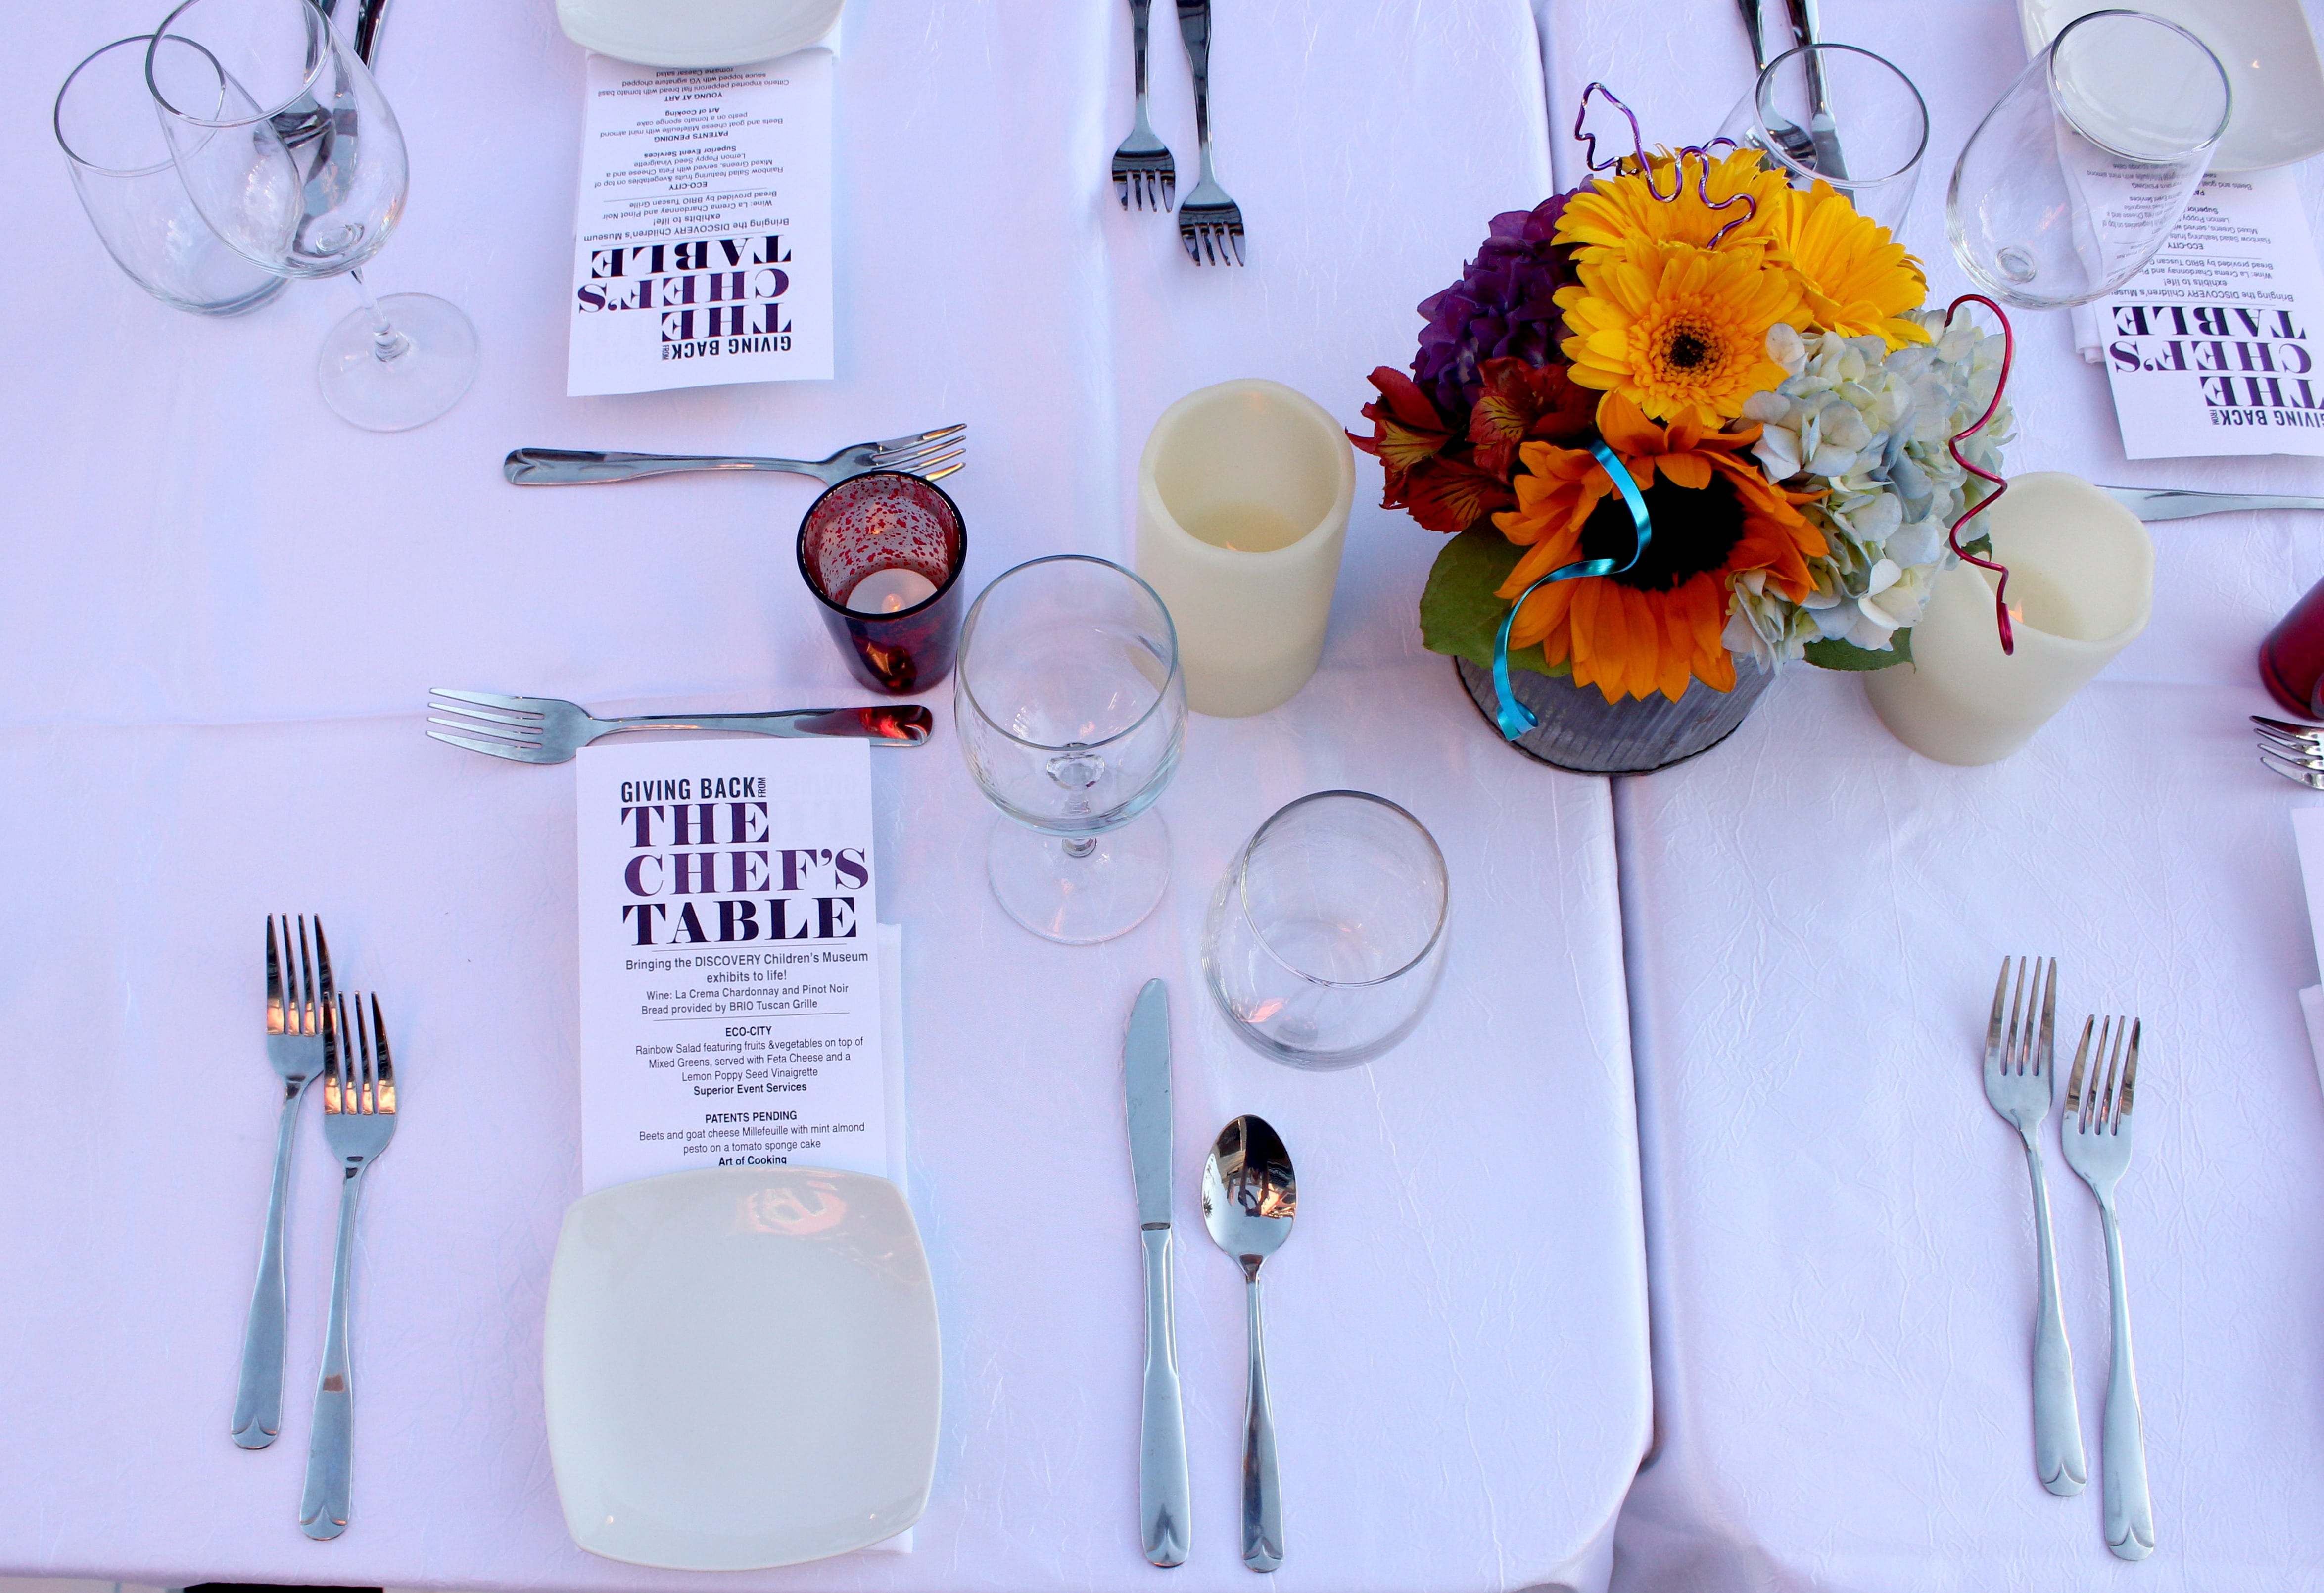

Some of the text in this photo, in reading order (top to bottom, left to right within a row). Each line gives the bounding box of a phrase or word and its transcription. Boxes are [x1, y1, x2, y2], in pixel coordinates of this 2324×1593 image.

[654, 131, 728, 143] PATENTS PENDING
[704, 145, 736, 153] Superior
[628, 175, 673, 185] &vegetables
[669, 181, 708, 190] ECO-CITY
[717, 192, 752, 202] provided
[661, 205, 708, 214] Chardonnay
[685, 213, 720, 223] exhibits
[750, 218, 789, 228] Bringing
[625, 228, 671, 239] Children's
[674, 223, 729, 235] DISCOVERY
[584, 233, 622, 241] Museum
[592, 235, 791, 278] TABLE
[2207, 259, 2216, 267] by
[2217, 260, 2250, 268] provided
[2167, 267, 2213, 276] Chardonnay
[2163, 278, 2180, 287] life!
[2192, 279, 2228, 287] exhibits
[578, 268, 789, 312] CHEF'S
[2139, 289, 2185, 297] Children's
[2187, 290, 2240, 299] DISCOVERY
[2257, 291, 2293, 302] Bringing
[662, 303, 791, 342] THE
[2112, 306, 2306, 339] TABLE
[672, 336, 791, 359] GIVING BACK
[2110, 341, 2311, 373] CHEF'S
[2200, 376, 2324, 410] THE
[2210, 410, 2219, 425] FROM
[2220, 410, 2267, 425] BACK
[621, 777, 755, 803] GIVING BACK
[758, 778, 766, 797] FROM
[621, 802, 769, 848] THE
[625, 848, 868, 897] CHEF'S
[623, 897, 856, 946] TABLE
[626, 952, 868, 972] Bringing the DISCOVERY Children's Museum
[707, 970, 787, 983] exhibits to life!
[646, 984, 849, 1000] Wine: La Crema Chardonnay and Pinot Noir
[642, 999, 817, 1015] Bread provided by BRIO Tuscan Grille
[725, 1026, 772, 1037] ECO-CITY
[636, 1045, 673, 1055] Rainbow
[676, 1043, 701, 1053] Salad
[704, 1041, 742, 1053] featuring
[744, 1040, 766, 1050] fruits
[838, 1038, 852, 1049] top
[855, 1036, 863, 1046] of
[649, 1058, 675, 1068] Mixed
[678, 1058, 712, 1067] Greens,
[715, 1055, 744, 1066] served
[747, 1055, 764, 1064] with
[767, 1054, 787, 1063] Feta
[790, 1053, 823, 1063] Cheese
[826, 1051, 842, 1061] and
[682, 1068, 818, 1082] Lemon Poppy Seed Vinaigrette
[694, 1082, 806, 1098] Superior Event Services
[706, 1110, 797, 1123] PATENTS PENDING
[639, 1122, 864, 1141] Beets and goat cheese Millefeuille with mint almond
[684, 1144, 708, 1156] pesto
[732, 1142, 762, 1151] tomato
[765, 1142, 798, 1152] sponge
[800, 1139, 821, 1148] cake
[718, 1155, 787, 1166] Art of Cooking
